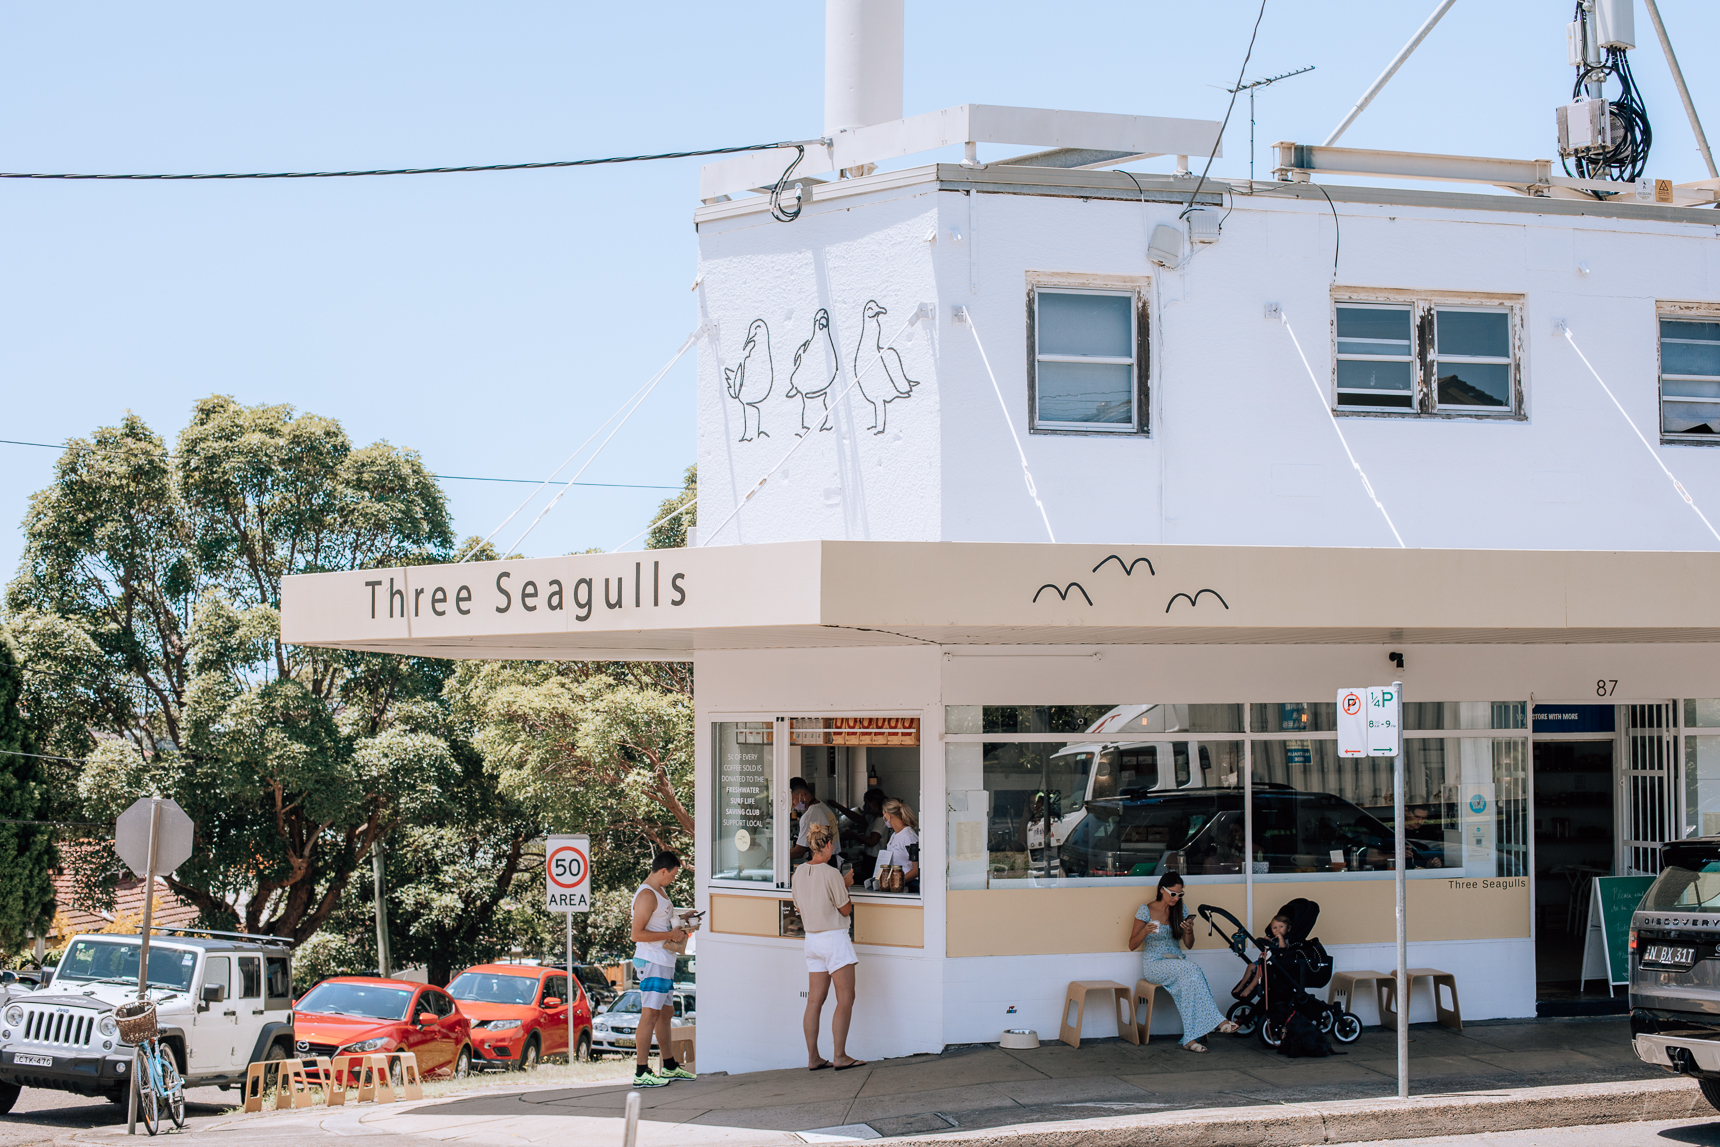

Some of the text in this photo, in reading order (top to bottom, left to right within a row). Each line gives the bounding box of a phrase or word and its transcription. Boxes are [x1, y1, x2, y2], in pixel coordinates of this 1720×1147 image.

[364, 560, 687, 622] Three Seagulls
[1596, 679, 1619, 697] 87
[746, 820, 762, 828] LOCAL
[555, 858, 581, 877] 50
[1448, 878, 1526, 890] Three Seagulls
[548, 893, 588, 907] AREA
[1644, 918, 1720, 927] DISCOVERY
